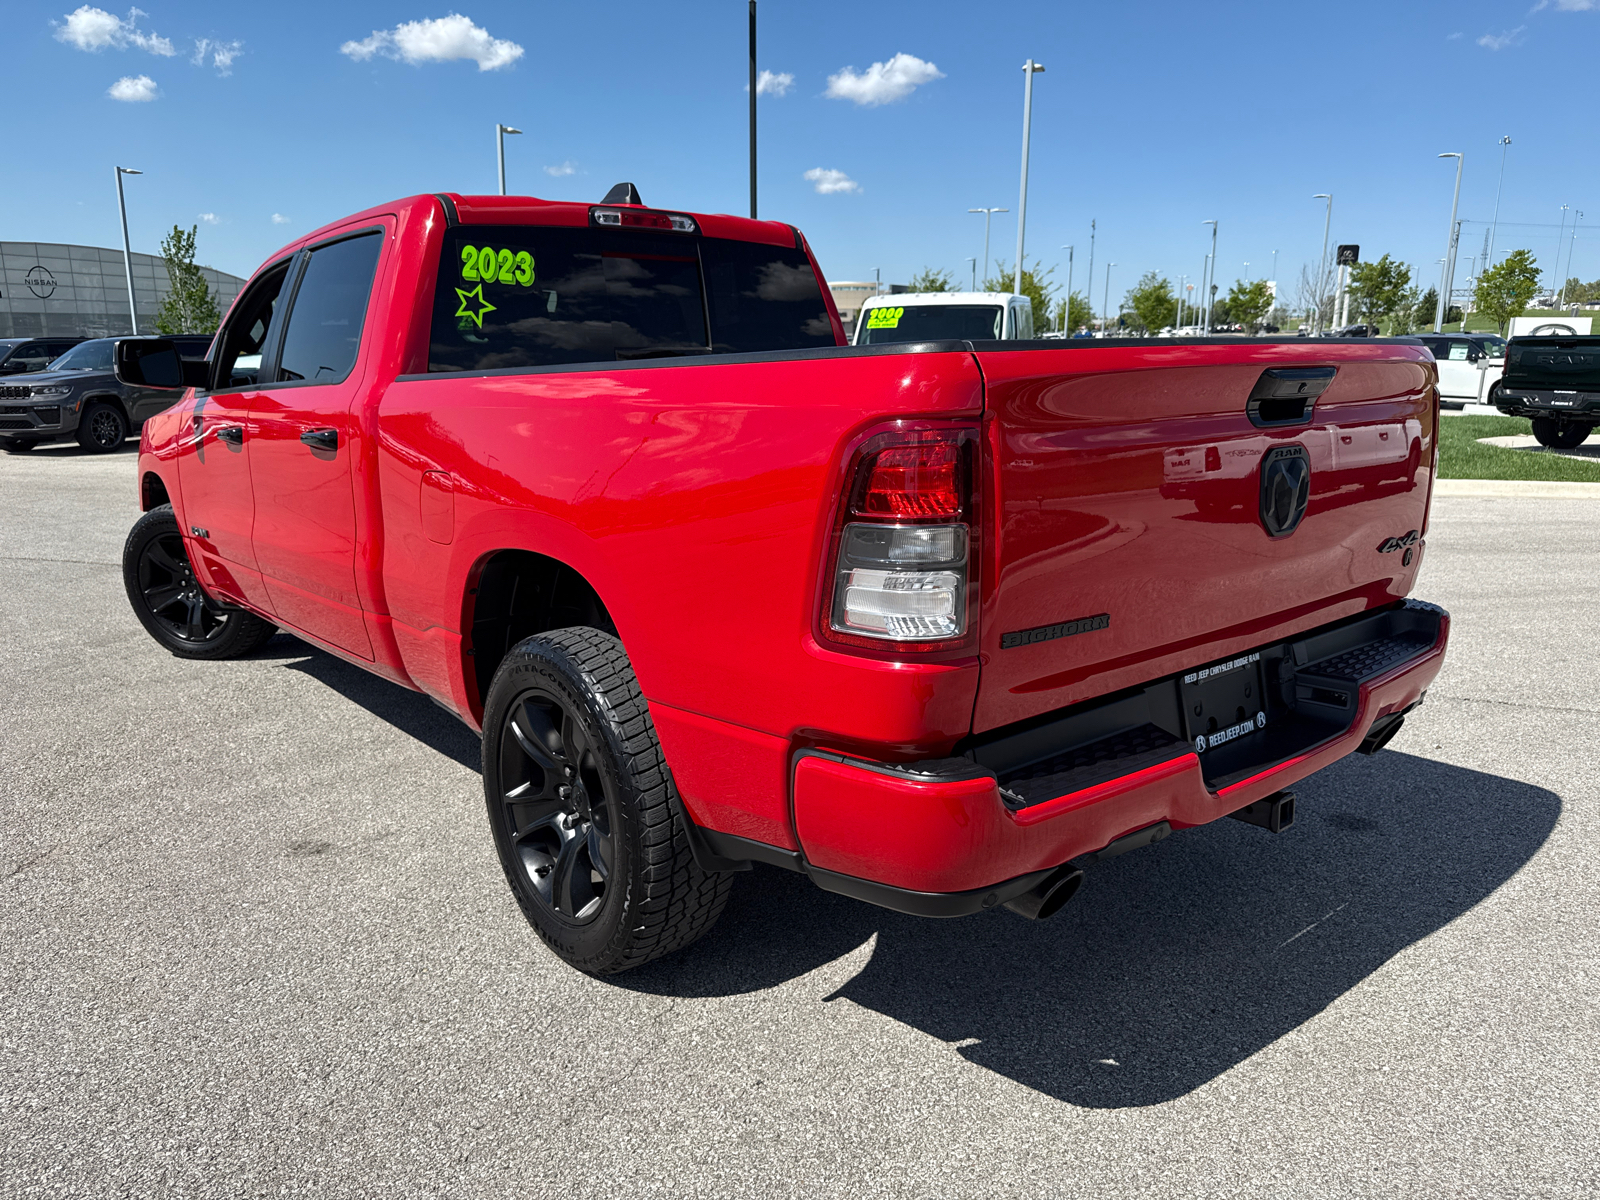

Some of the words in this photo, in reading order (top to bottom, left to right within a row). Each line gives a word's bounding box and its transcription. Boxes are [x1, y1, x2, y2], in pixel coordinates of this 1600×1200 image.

[461, 244, 535, 287] 2023
[1537, 356, 1594, 365] RAM
[1274, 447, 1302, 458] RAM
[1000, 613, 1110, 649] BIGHORN
[1184, 673, 1197, 685] REED
[1198, 669, 1209, 679] JEEP
[1210, 661, 1233, 676] CHRYSLER
[1234, 656, 1248, 668] DODGE
[1248, 652, 1260, 663] RAM
[1209, 719, 1254, 748] REEDJEEP.COM
